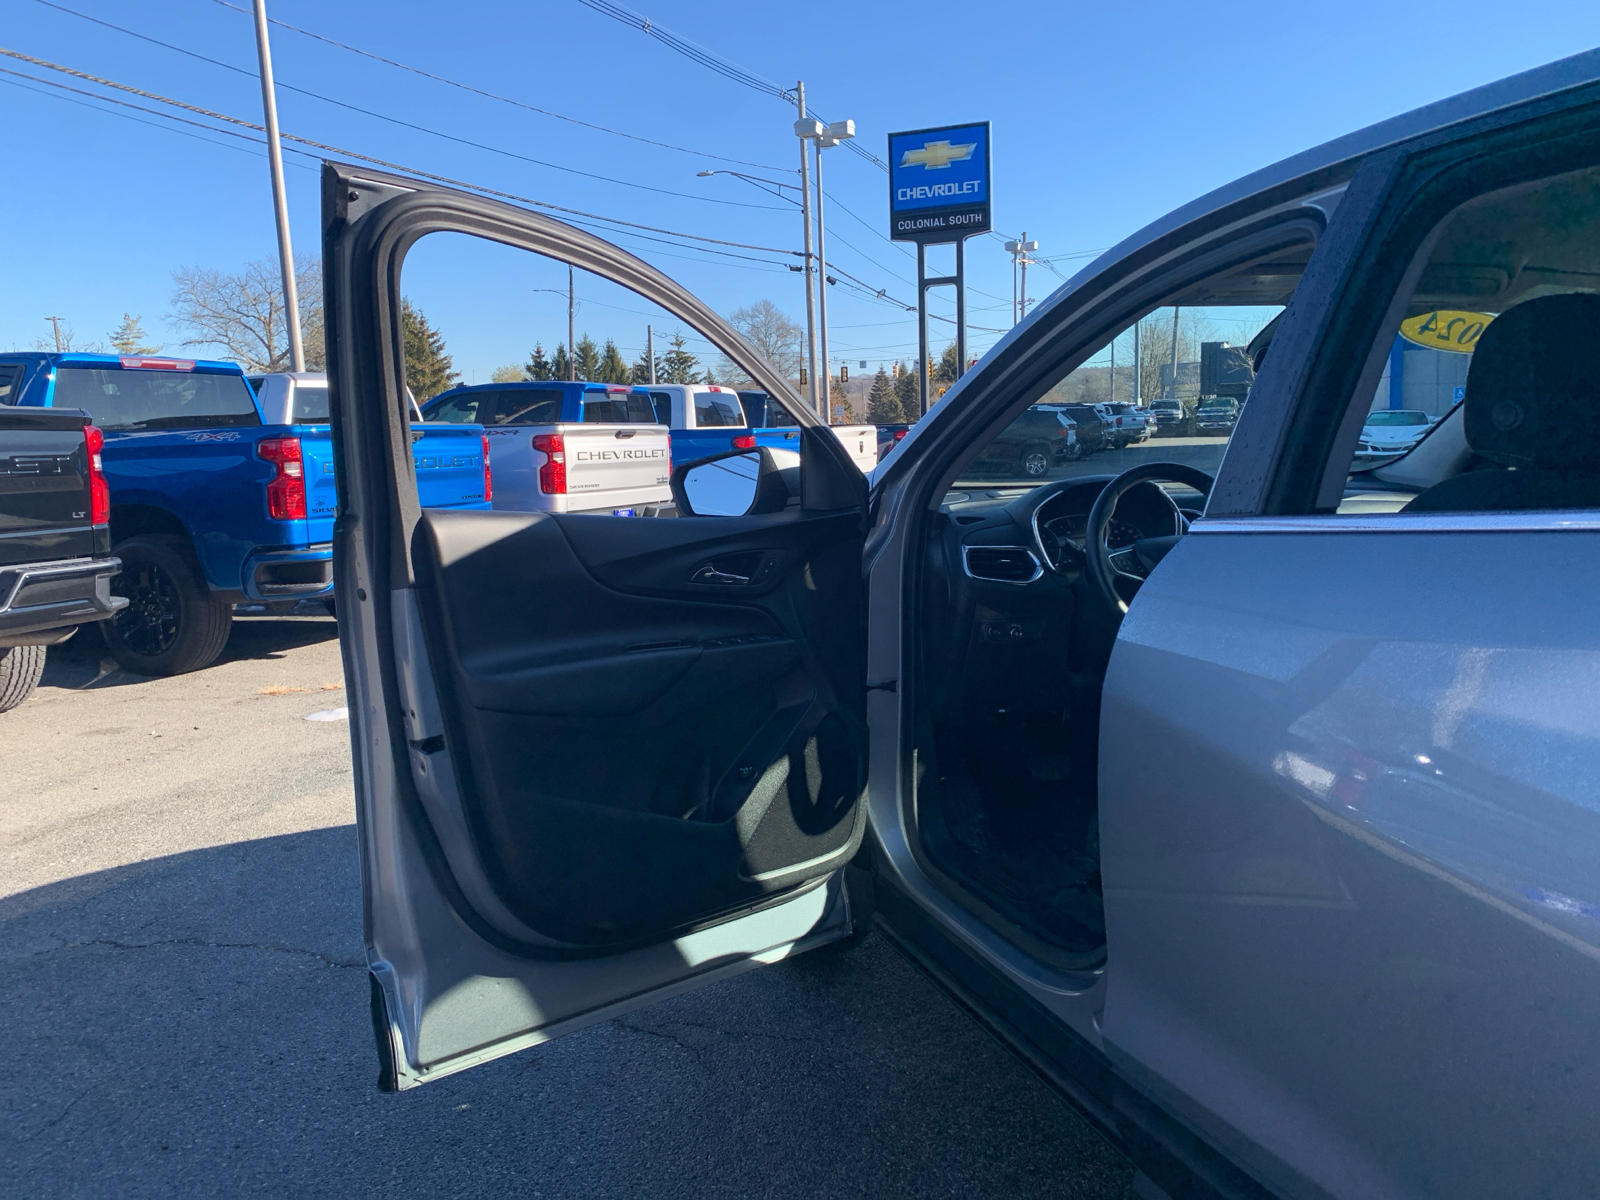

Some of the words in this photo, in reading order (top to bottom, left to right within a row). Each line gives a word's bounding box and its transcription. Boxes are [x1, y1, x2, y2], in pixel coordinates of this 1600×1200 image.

[898, 180, 980, 200] CHEVROLET
[898, 218, 945, 230] COLONIAL
[949, 213, 982, 225] SOUTH
[577, 449, 665, 461] CHEVROLET
[72, 511, 86, 519] LT
